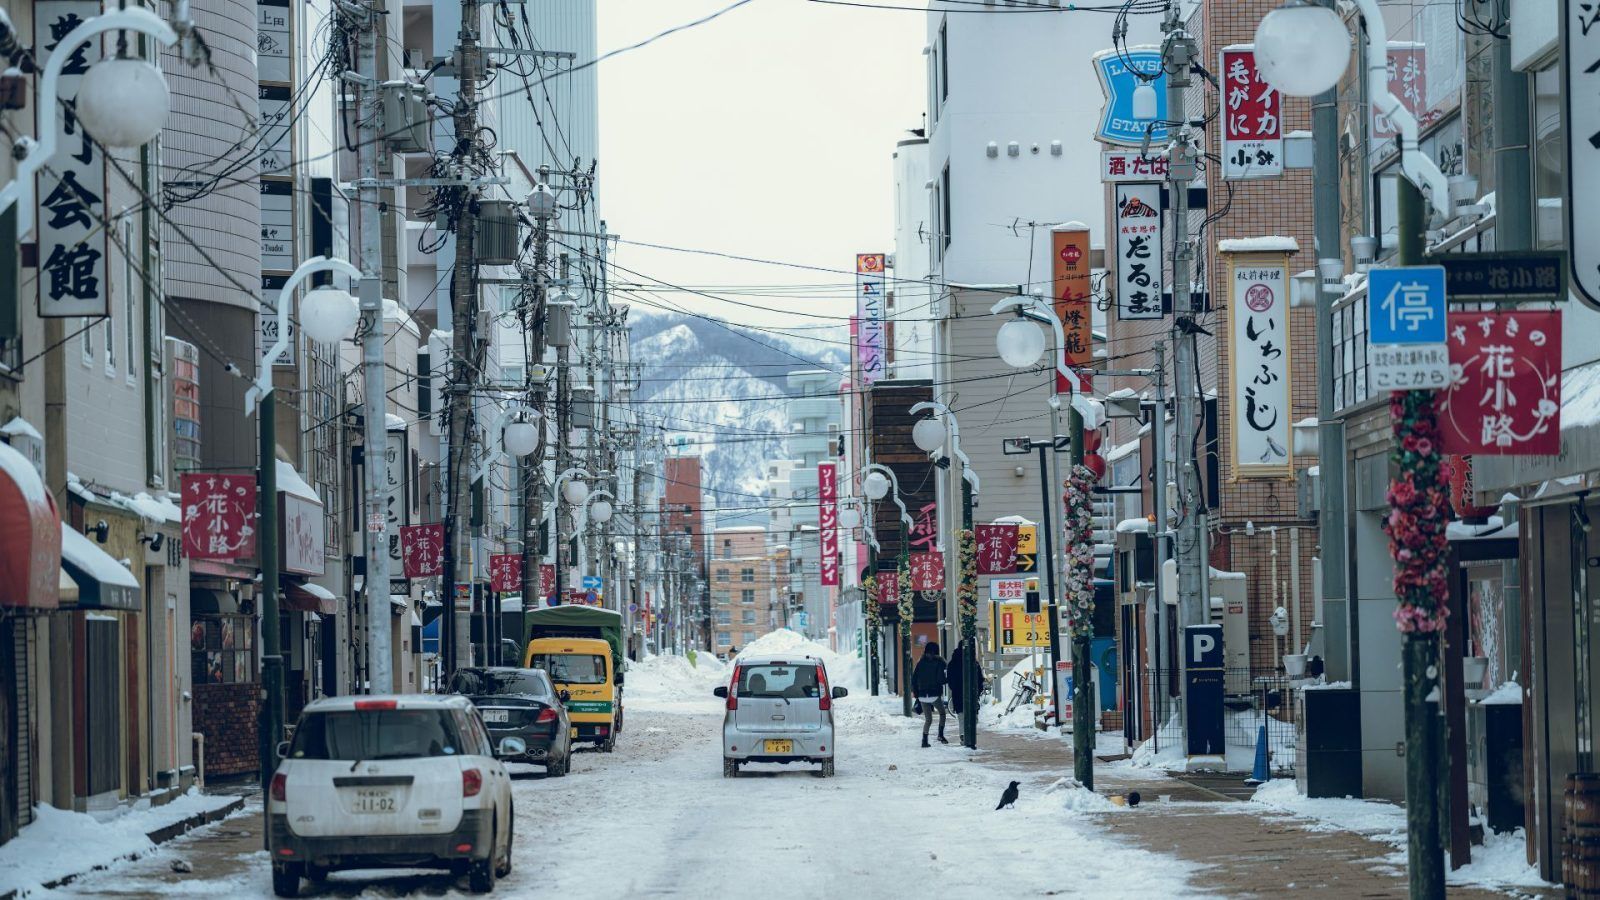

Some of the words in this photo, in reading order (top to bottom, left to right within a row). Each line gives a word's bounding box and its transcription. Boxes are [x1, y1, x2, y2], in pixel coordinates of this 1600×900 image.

[1227, 58, 1250, 136] 毛がに
[1126, 235, 1151, 314] だるま
[1237, 270, 1281, 281] 板前料理
[1488, 264, 1557, 289] 花小路
[1061, 286, 1087, 355] 紅燈籠
[1381, 281, 1435, 332] 停
[1450, 316, 1547, 347] すすきの
[1245, 315, 1282, 432] いちふじ
[1377, 369, 1445, 386] ここから
[1479, 345, 1517, 447] 花小路
[190, 477, 248, 497] すすきの
[822, 467, 832, 497] ソープ
[206, 493, 229, 555] 花小路
[406, 527, 440, 539] すすきの
[981, 527, 1014, 538] すすきの
[417, 537, 433, 574] 花小路
[821, 500, 836, 582] ヤングレディ
[990, 536, 1003, 572] 花小路
[501, 563, 512, 590] 花小路
[922, 561, 933, 589] 花小路
[1193, 634, 1215, 663] P
